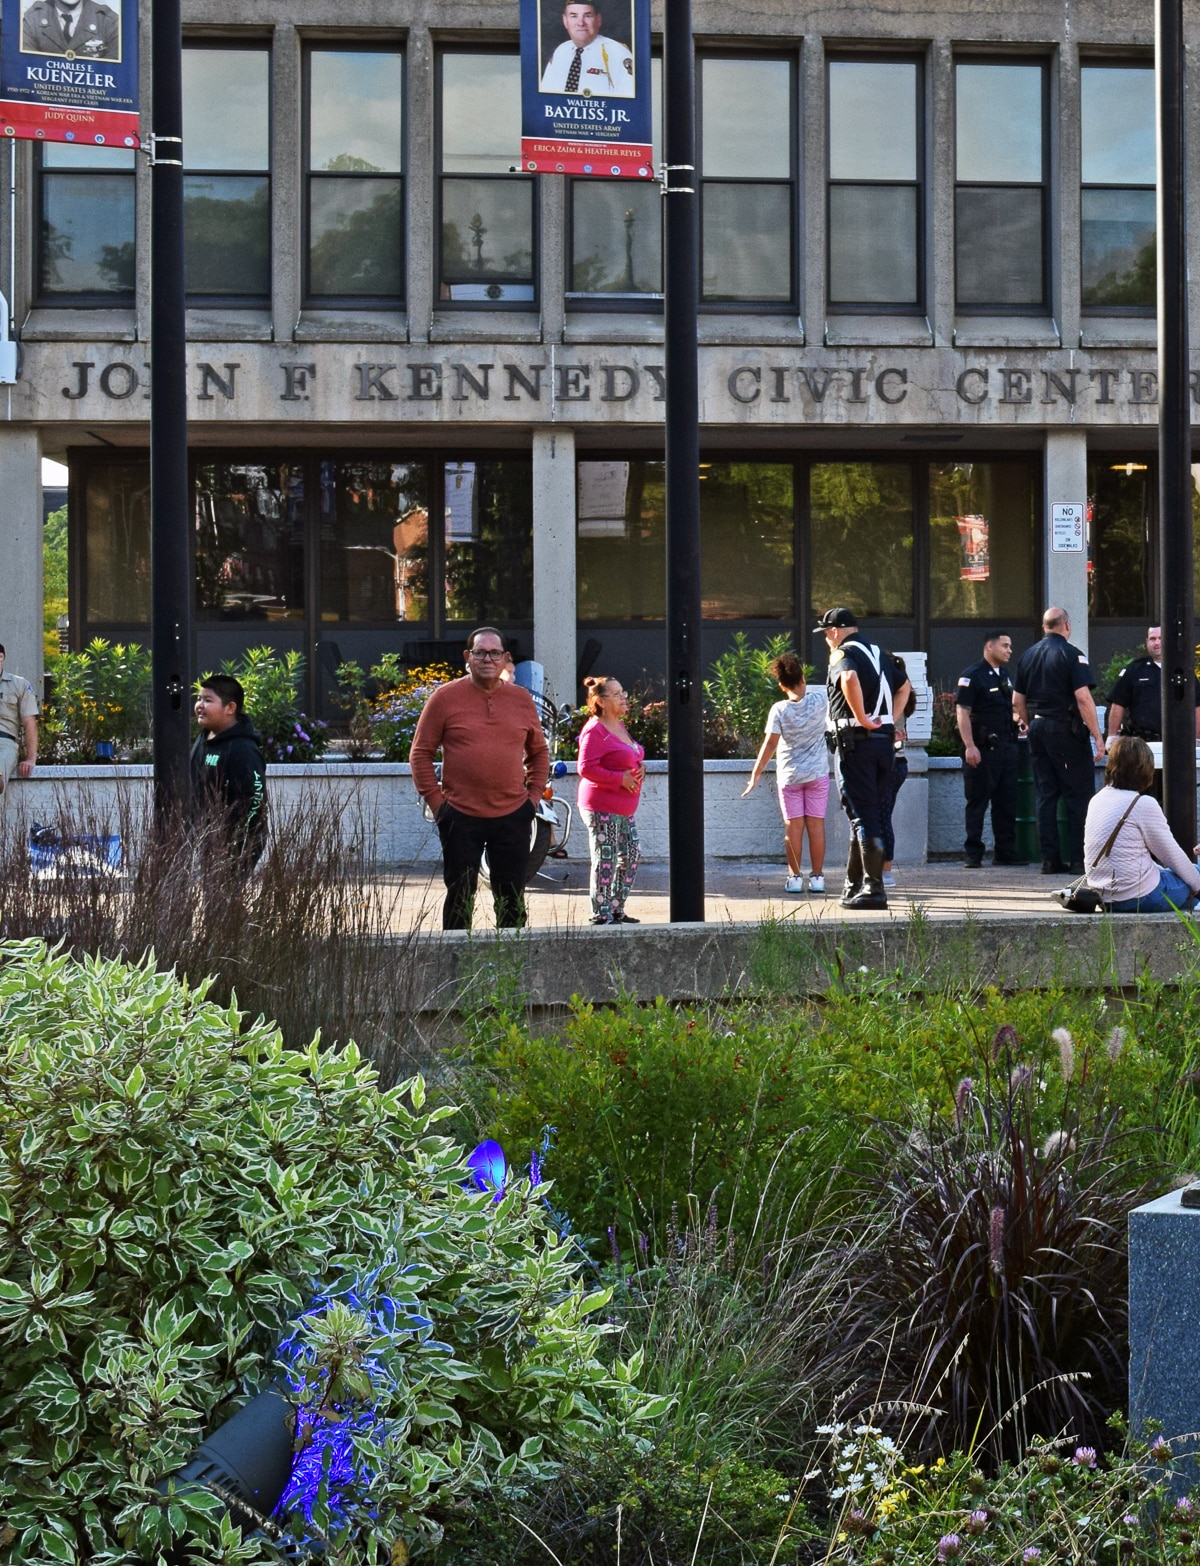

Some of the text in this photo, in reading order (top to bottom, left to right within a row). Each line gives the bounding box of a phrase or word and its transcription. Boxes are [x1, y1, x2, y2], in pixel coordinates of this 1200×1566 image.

[46, 60, 86, 72] CHARLES
[26, 66, 116, 88] KUENZLER
[34, 82, 107, 96] UNITED STATES ARMY
[567, 98, 598, 108] WALTER
[44, 111, 95, 123] JUDY QUINN
[544, 105, 631, 124] BAYLISS, JR.
[553, 122, 580, 130] UNITED
[533, 144, 556, 152] ERICA
[584, 148, 619, 156] HEATHER
[61, 361, 241, 401] JON
[727, 366, 910, 404] CIVIC
[1062, 508, 1074, 516] NO
